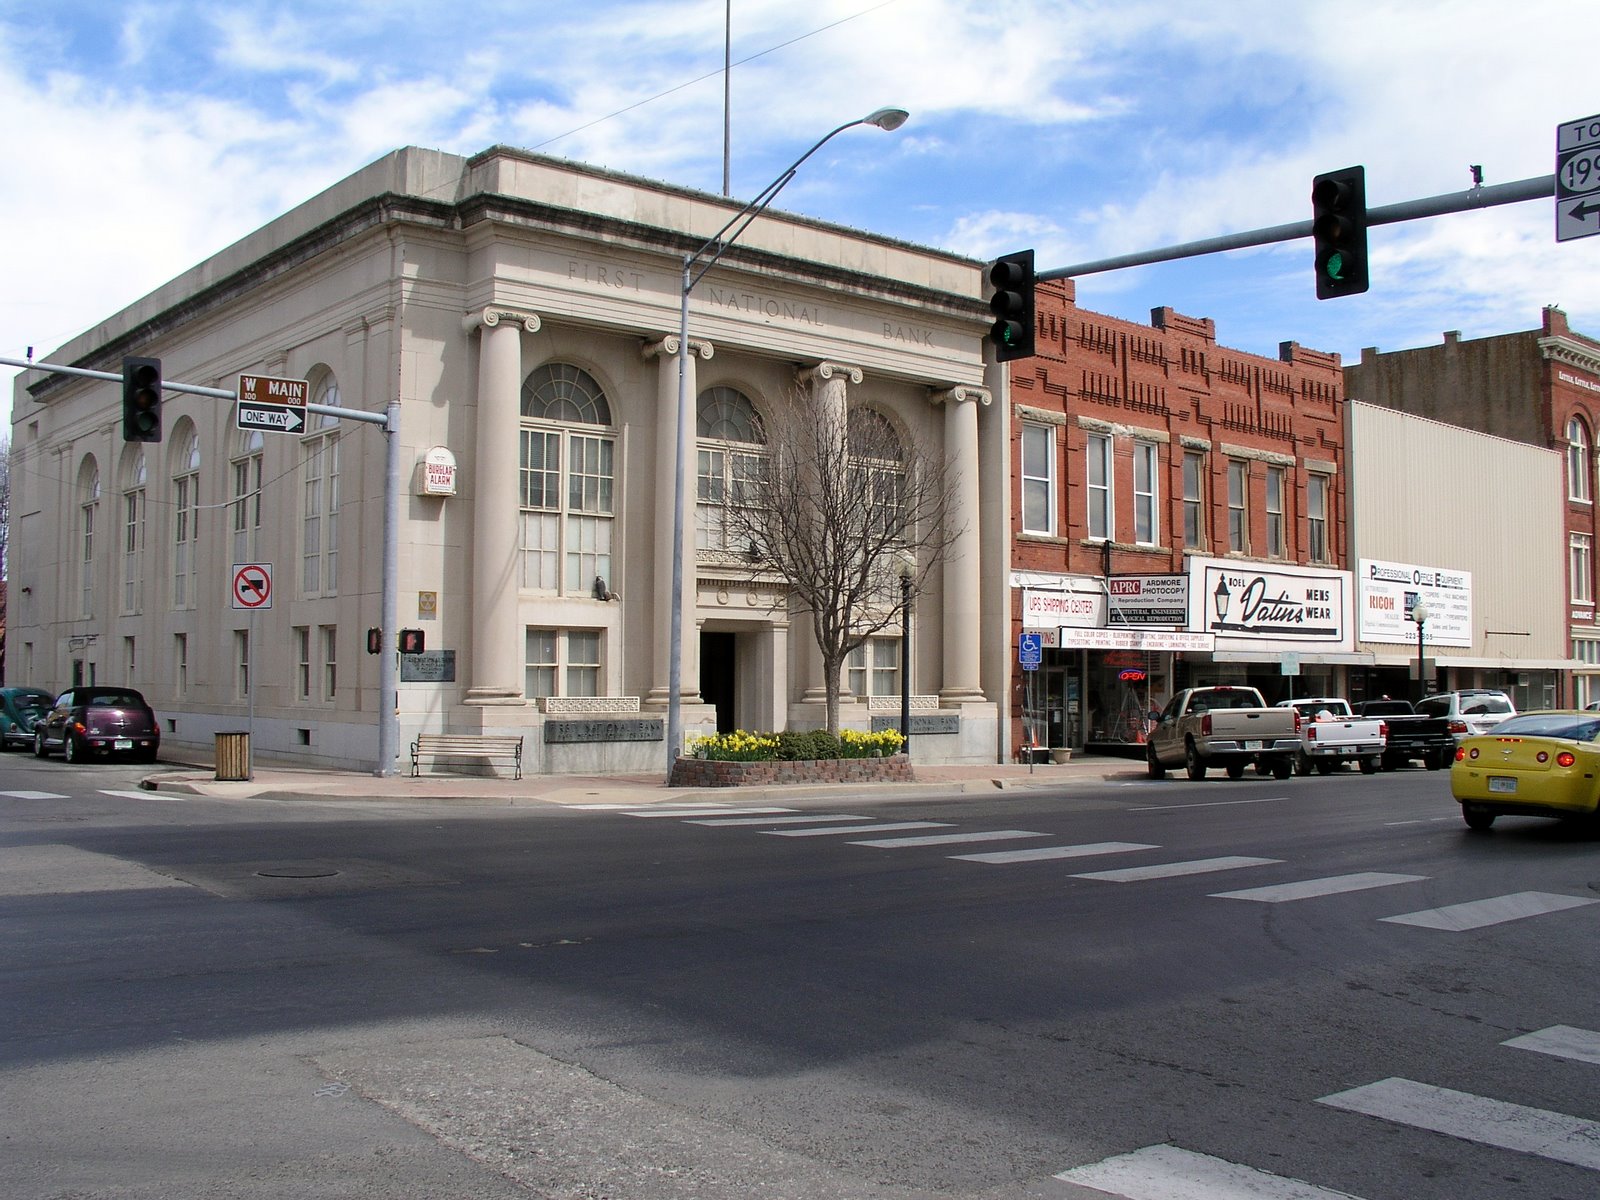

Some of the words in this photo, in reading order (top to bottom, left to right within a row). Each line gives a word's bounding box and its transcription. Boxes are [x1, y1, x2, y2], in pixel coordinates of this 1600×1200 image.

[568, 261, 645, 292] FIRST
[709, 288, 824, 327] NATIONAL
[883, 322, 935, 348] BANK
[245, 378, 256, 392] W
[269, 381, 302, 397] MAIN
[246, 411, 265, 422] ONE
[269, 413, 289, 424] WAY
[429, 464, 453, 475] BURGLAR
[430, 475, 450, 485] ALARM
[1111, 581, 1140, 594] APRC
[1229, 578, 1246, 587] NOEL
[1306, 589, 1330, 602] MENS
[1029, 596, 1041, 611] UPS
[1043, 597, 1069, 613] SHIPPING
[1071, 599, 1094, 614] CENTER
[1370, 595, 1394, 610] RICOH
[1306, 607, 1331, 619] WEAR
[1120, 672, 1146, 680] OPEN
